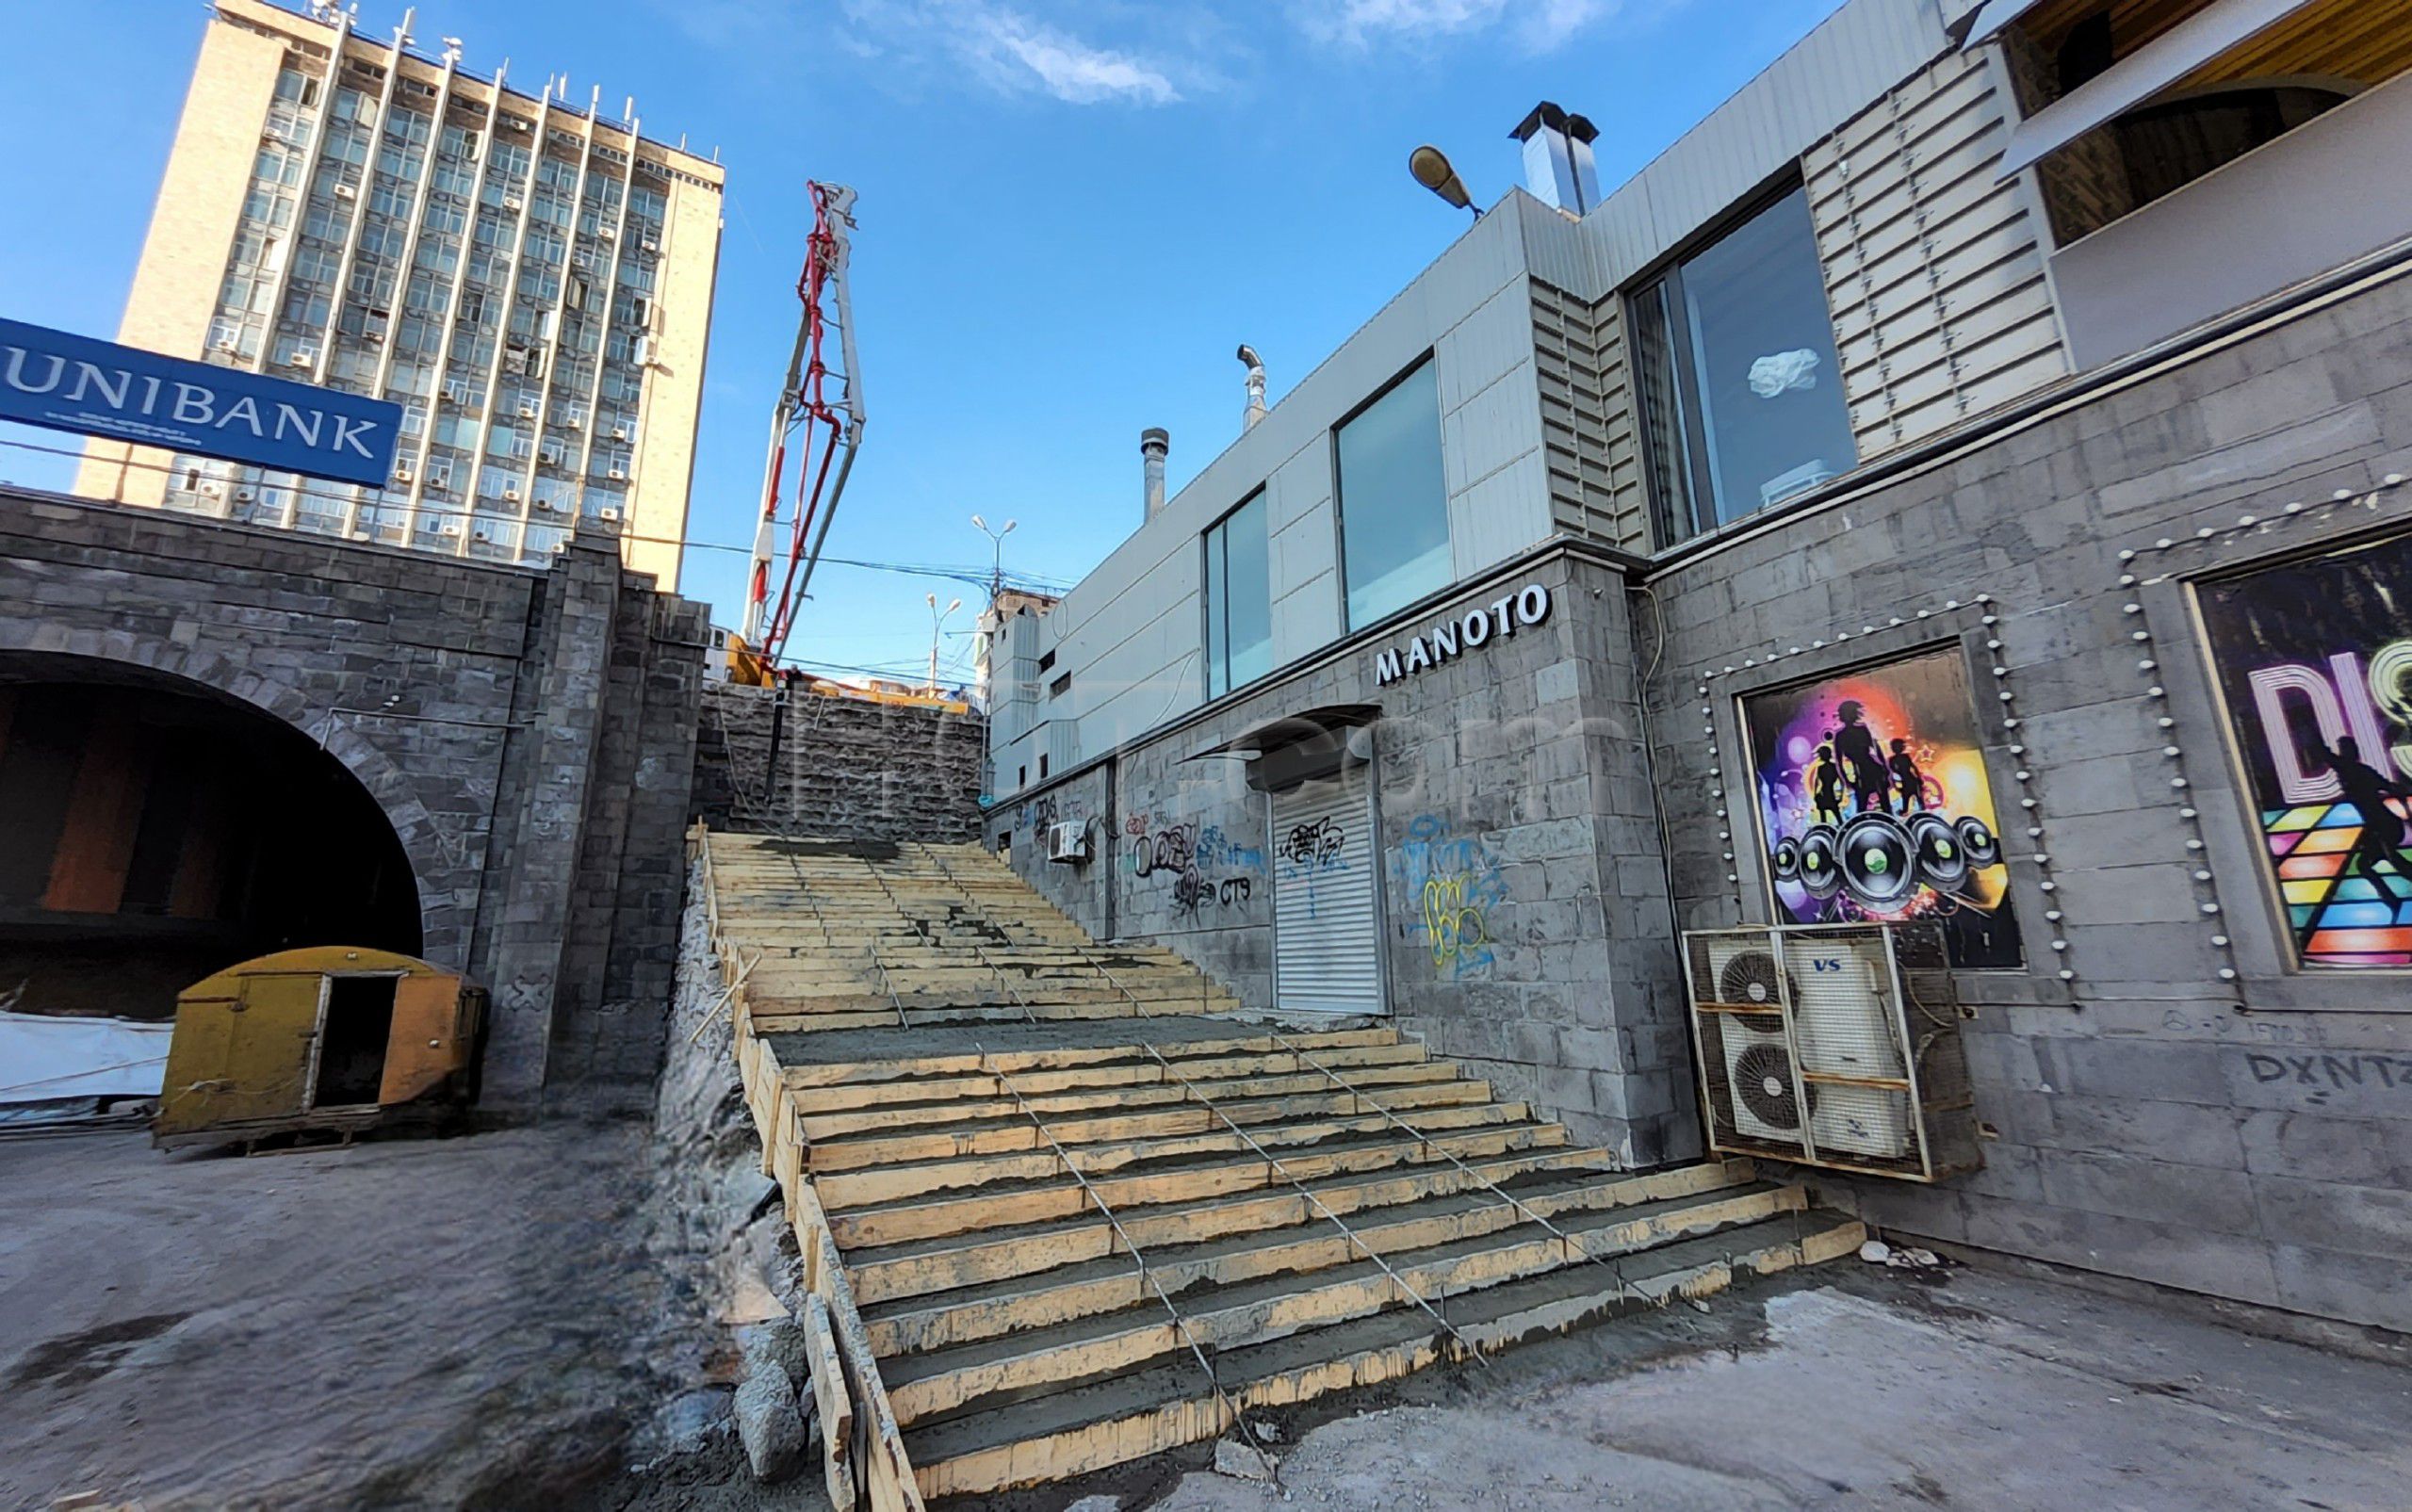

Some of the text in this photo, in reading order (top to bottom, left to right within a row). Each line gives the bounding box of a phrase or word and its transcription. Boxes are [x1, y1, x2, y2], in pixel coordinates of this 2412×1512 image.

[2, 347, 378, 459] UNIBANK
[1375, 584, 1550, 686] MANOTO
[1813, 958, 1841, 972] VS
